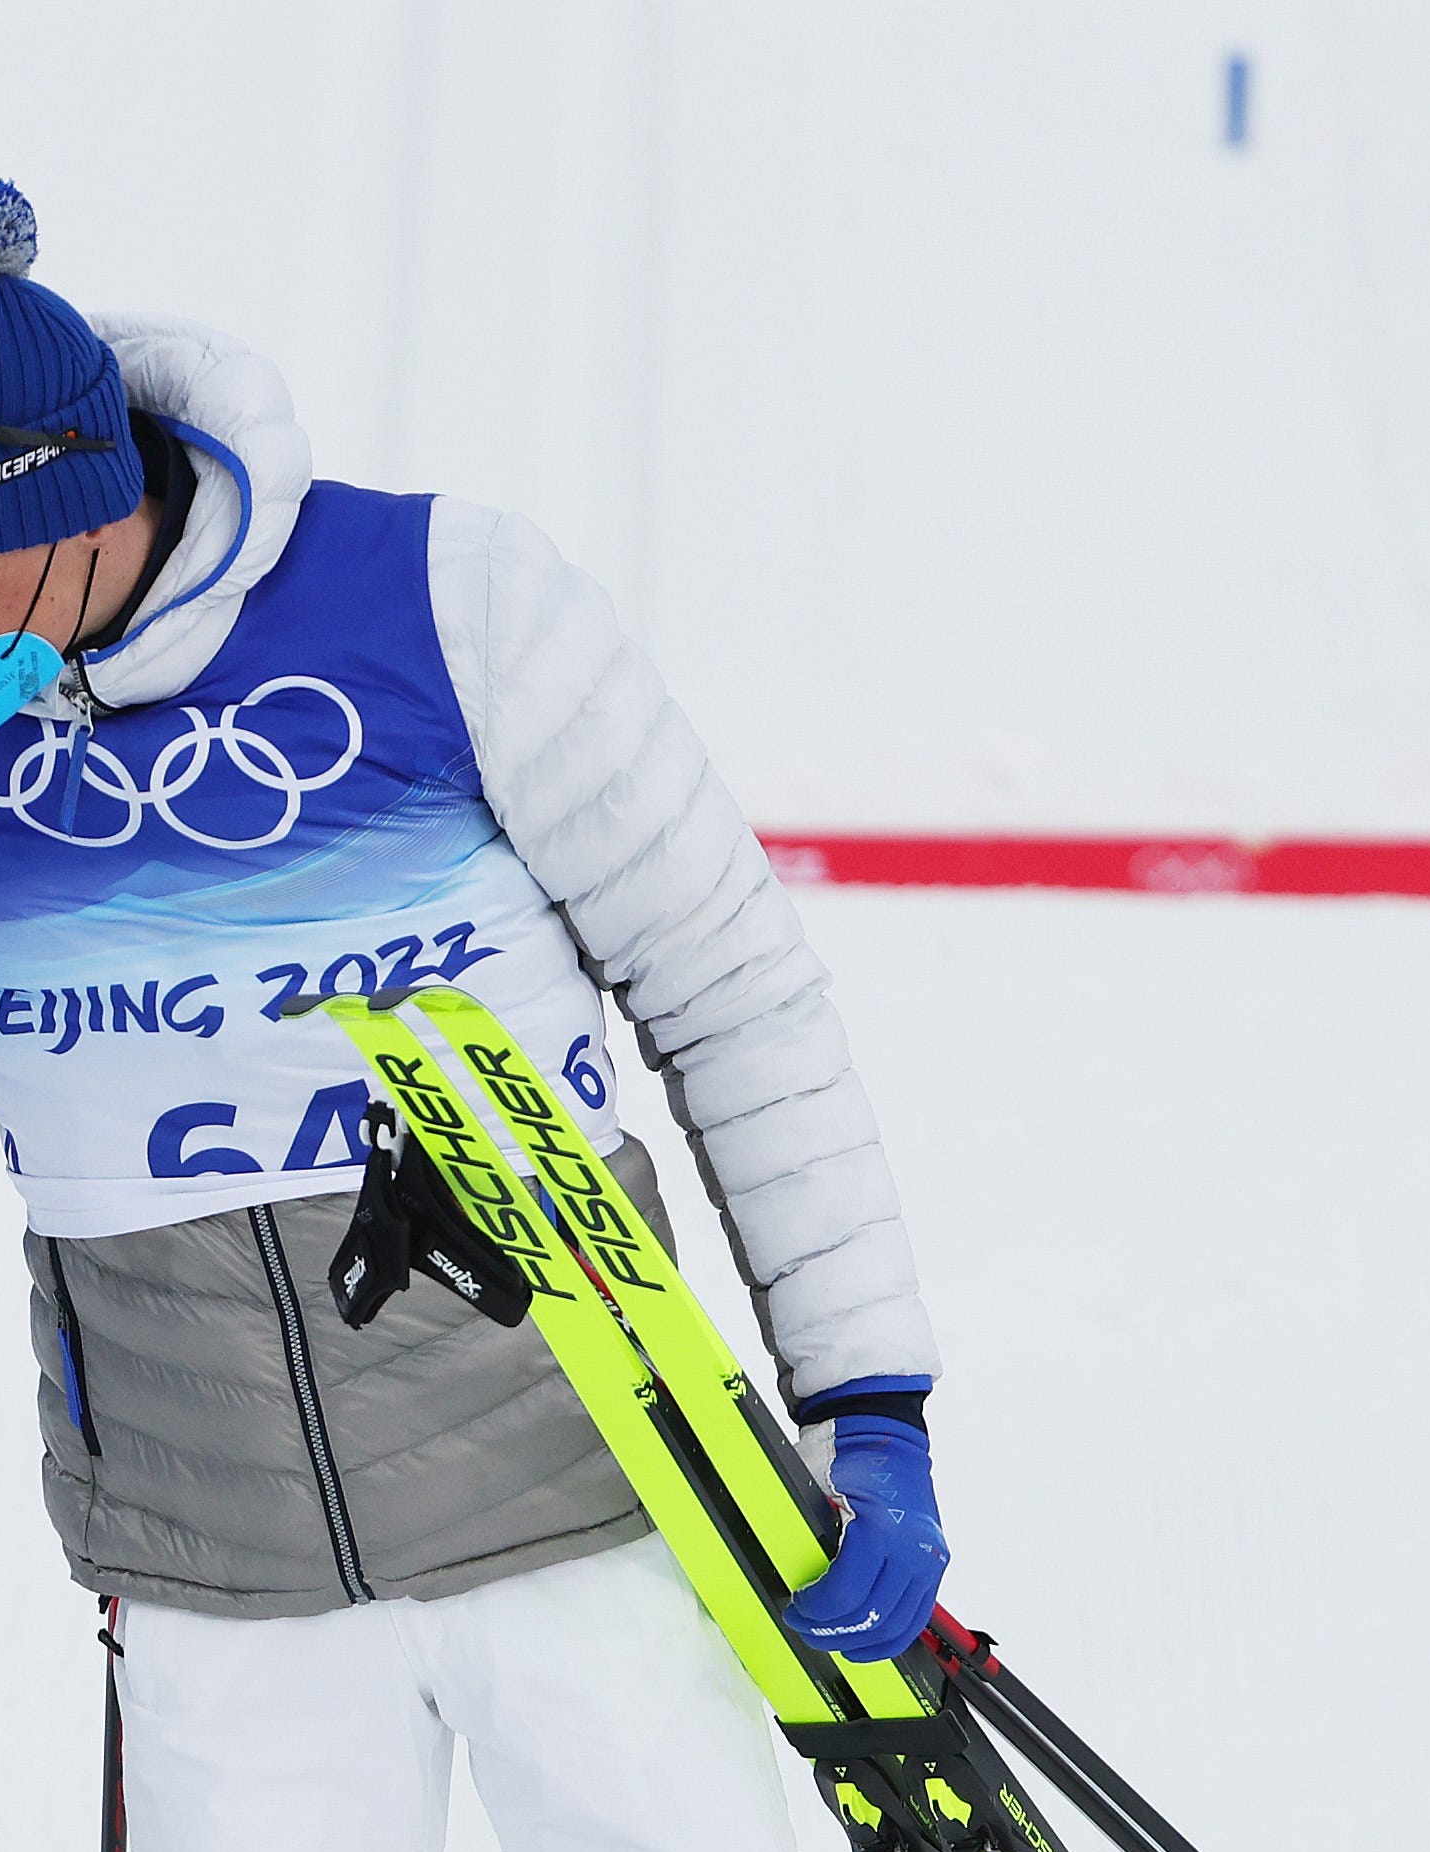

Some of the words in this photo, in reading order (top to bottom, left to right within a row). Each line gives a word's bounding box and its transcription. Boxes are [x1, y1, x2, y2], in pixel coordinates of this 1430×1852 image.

[255, 921, 503, 1023] 2022
[375, 1053, 578, 1302] FISCHER
[463, 1043, 667, 1293] FISCHER
